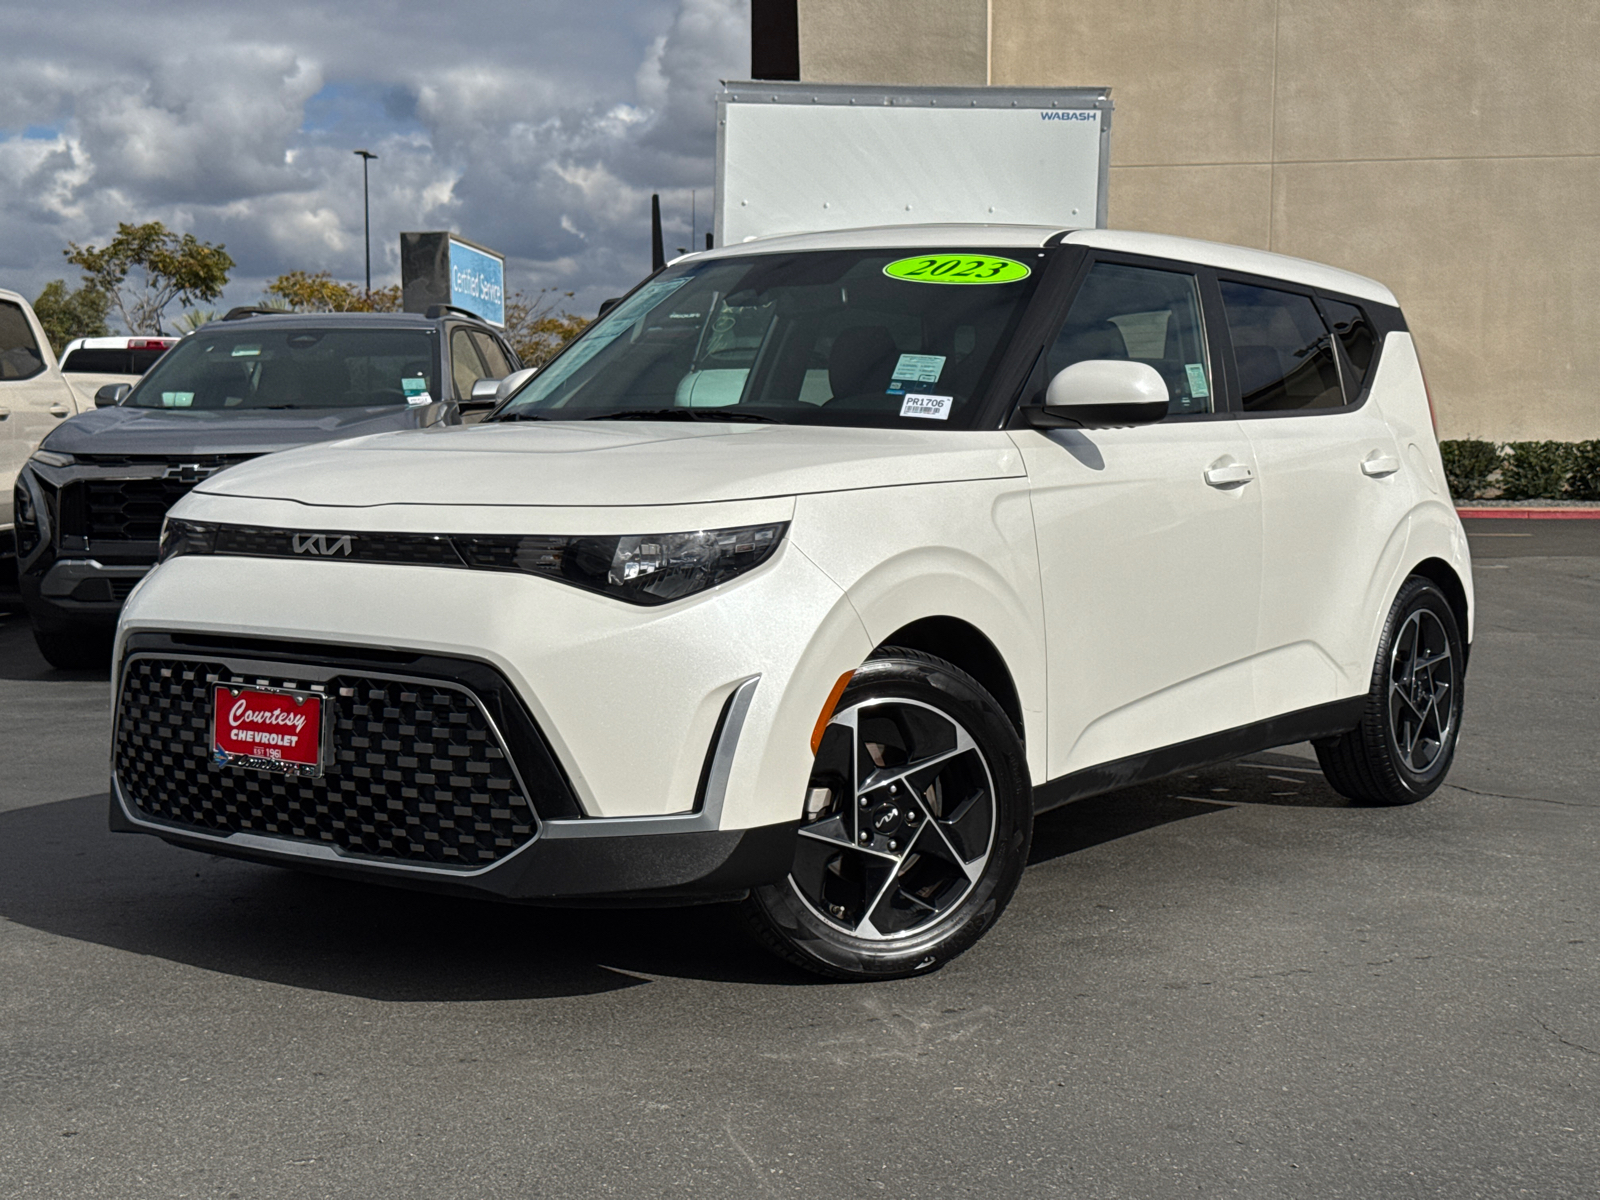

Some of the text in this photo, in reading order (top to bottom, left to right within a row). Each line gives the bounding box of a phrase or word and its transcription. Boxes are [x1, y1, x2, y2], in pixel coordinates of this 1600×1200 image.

[1040, 111, 1097, 121] WABASH
[903, 259, 1009, 278] 2023
[453, 264, 501, 305] Certified Service
[906, 397, 945, 408] PR1706
[292, 533, 352, 557] KIA
[228, 699, 307, 734] Courtesy
[230, 729, 299, 747] CHEVROLET
